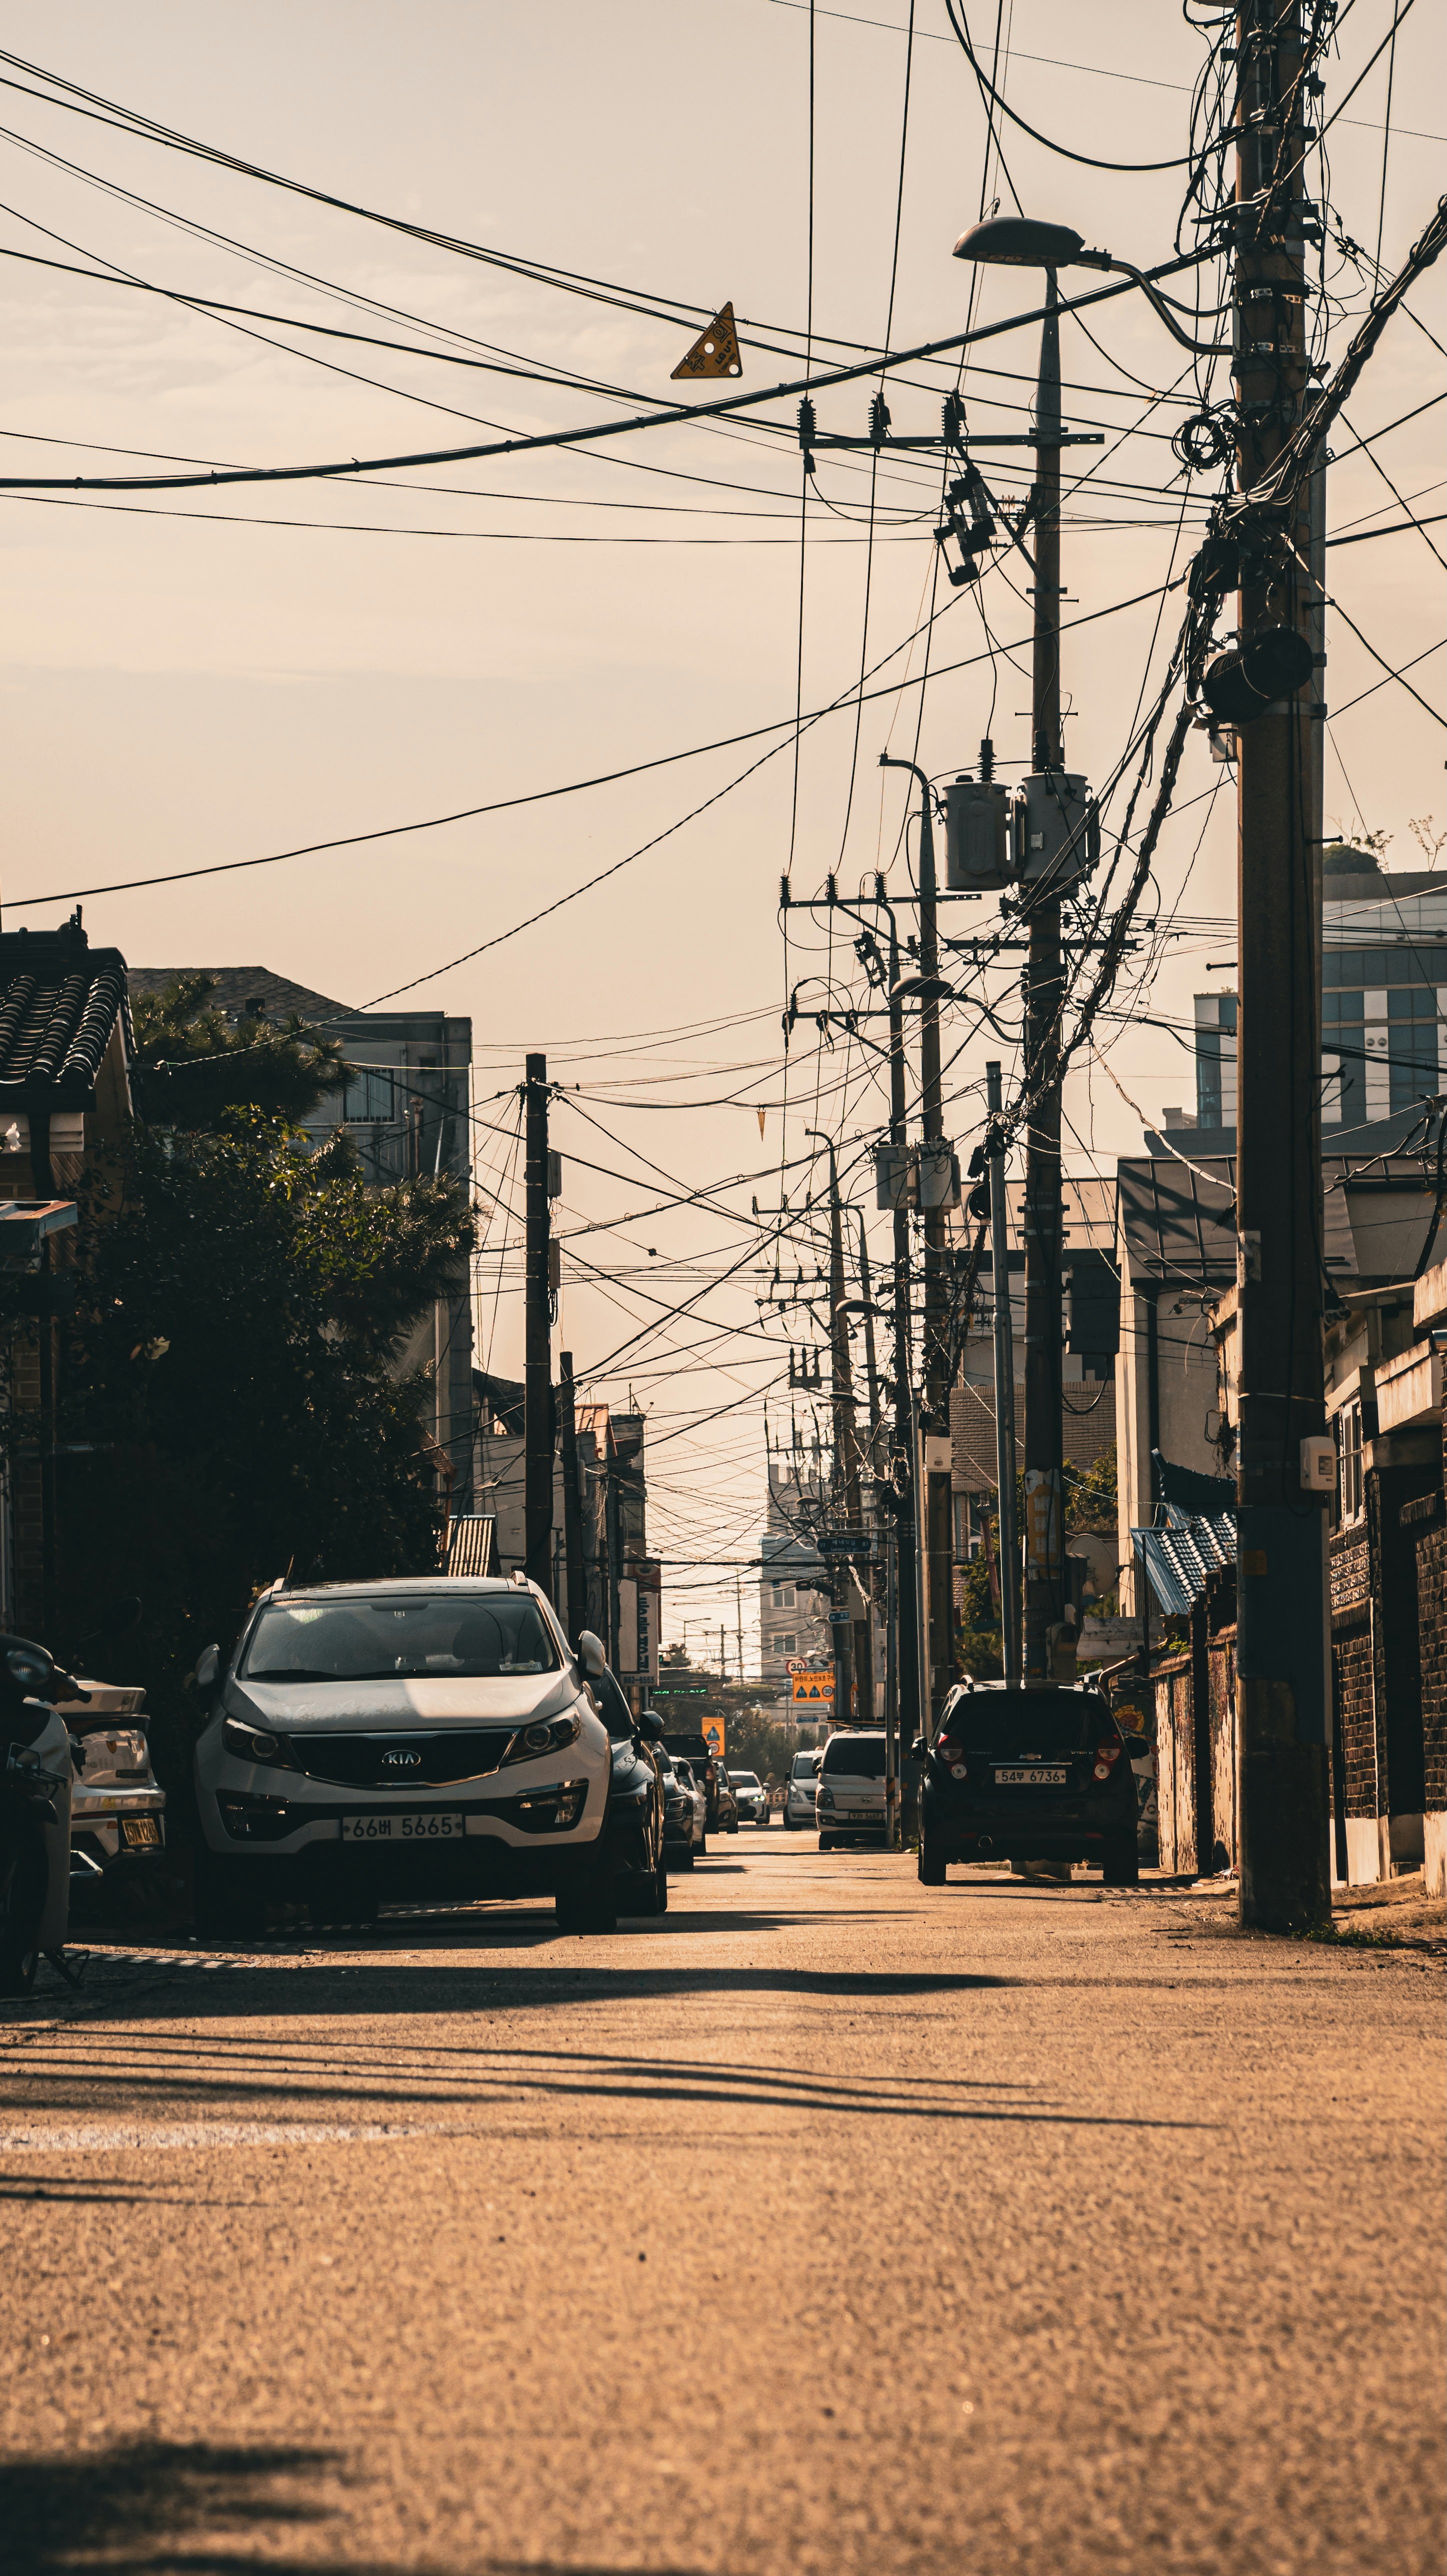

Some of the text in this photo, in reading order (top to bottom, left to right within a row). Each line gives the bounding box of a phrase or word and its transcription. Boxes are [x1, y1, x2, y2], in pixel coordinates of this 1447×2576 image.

[715, 352, 726, 365] LG
[791, 1663, 802, 1671] 30
[624, 1676, 655, 1684] 862-6555
[388, 1753, 414, 1764] KIA
[1030, 1771, 1060, 1782] 6736
[353, 1817, 452, 1838] 66버 5665
